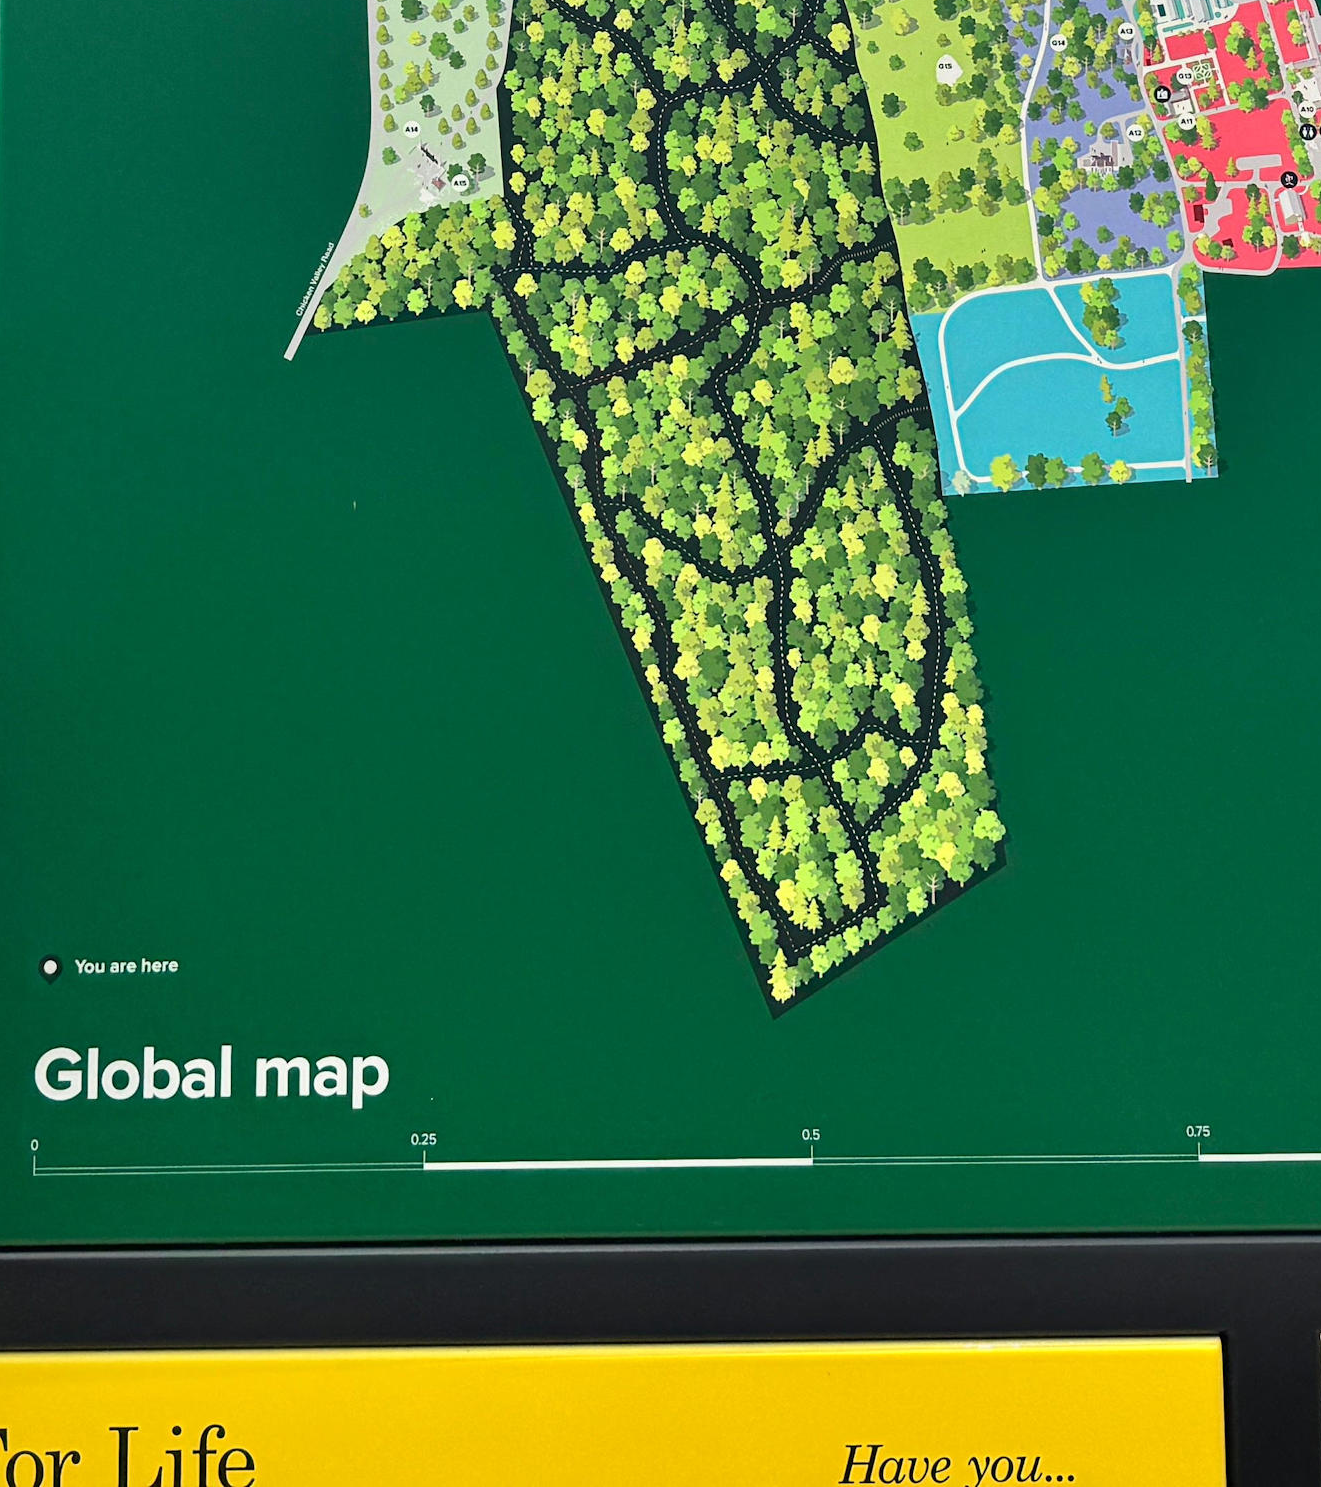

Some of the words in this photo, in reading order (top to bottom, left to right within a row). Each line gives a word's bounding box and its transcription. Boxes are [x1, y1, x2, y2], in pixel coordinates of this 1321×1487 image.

[74, 959, 106, 974] You
[109, 961, 138, 974] are
[141, 957, 179, 973] here
[34, 1044, 233, 1102] Global
[255, 1055, 390, 1110] map
[410, 1132, 437, 1146] 0.25
[801, 1128, 821, 1141] 0.5
[1185, 1125, 1211, 1138] 0.75
[30, 1138, 39, 1152] 0
[108, 1424, 255, 1487] Life
[837, 1444, 951, 1485] Have
[964, 1456, 1075, 1487] you...
